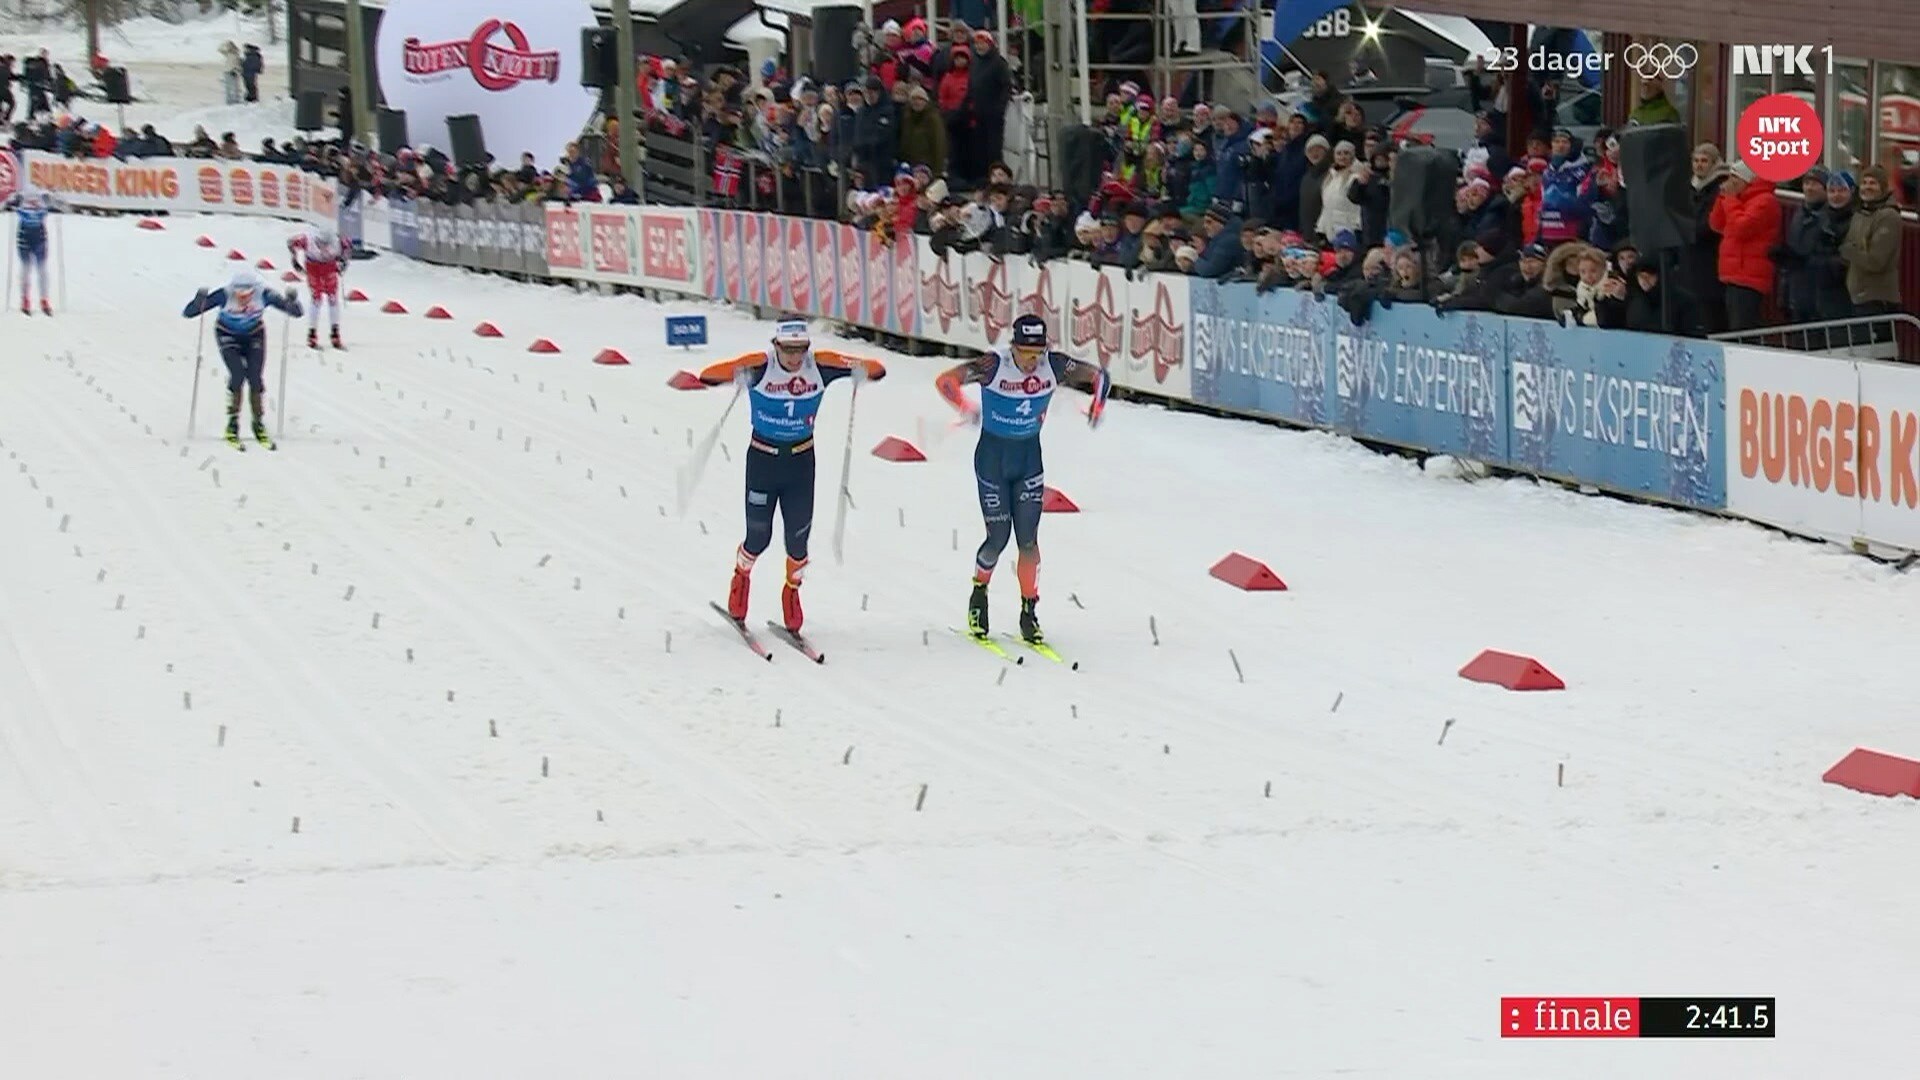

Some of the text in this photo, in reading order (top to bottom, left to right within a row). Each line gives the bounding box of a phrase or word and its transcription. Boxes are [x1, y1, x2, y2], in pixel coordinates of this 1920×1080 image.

[29, 160, 110, 196] BURGER
[115, 167, 180, 199] KING
[1241, 321, 1326, 397] EKSPERTEN
[1350, 338, 1497, 419] VVS EKSPERTEN
[784, 401, 796, 417] 1
[1016, 400, 1032, 416] 4
[1534, 365, 1709, 460] VVS EKSPERTEN
[1739, 387, 1881, 502] BURGER
